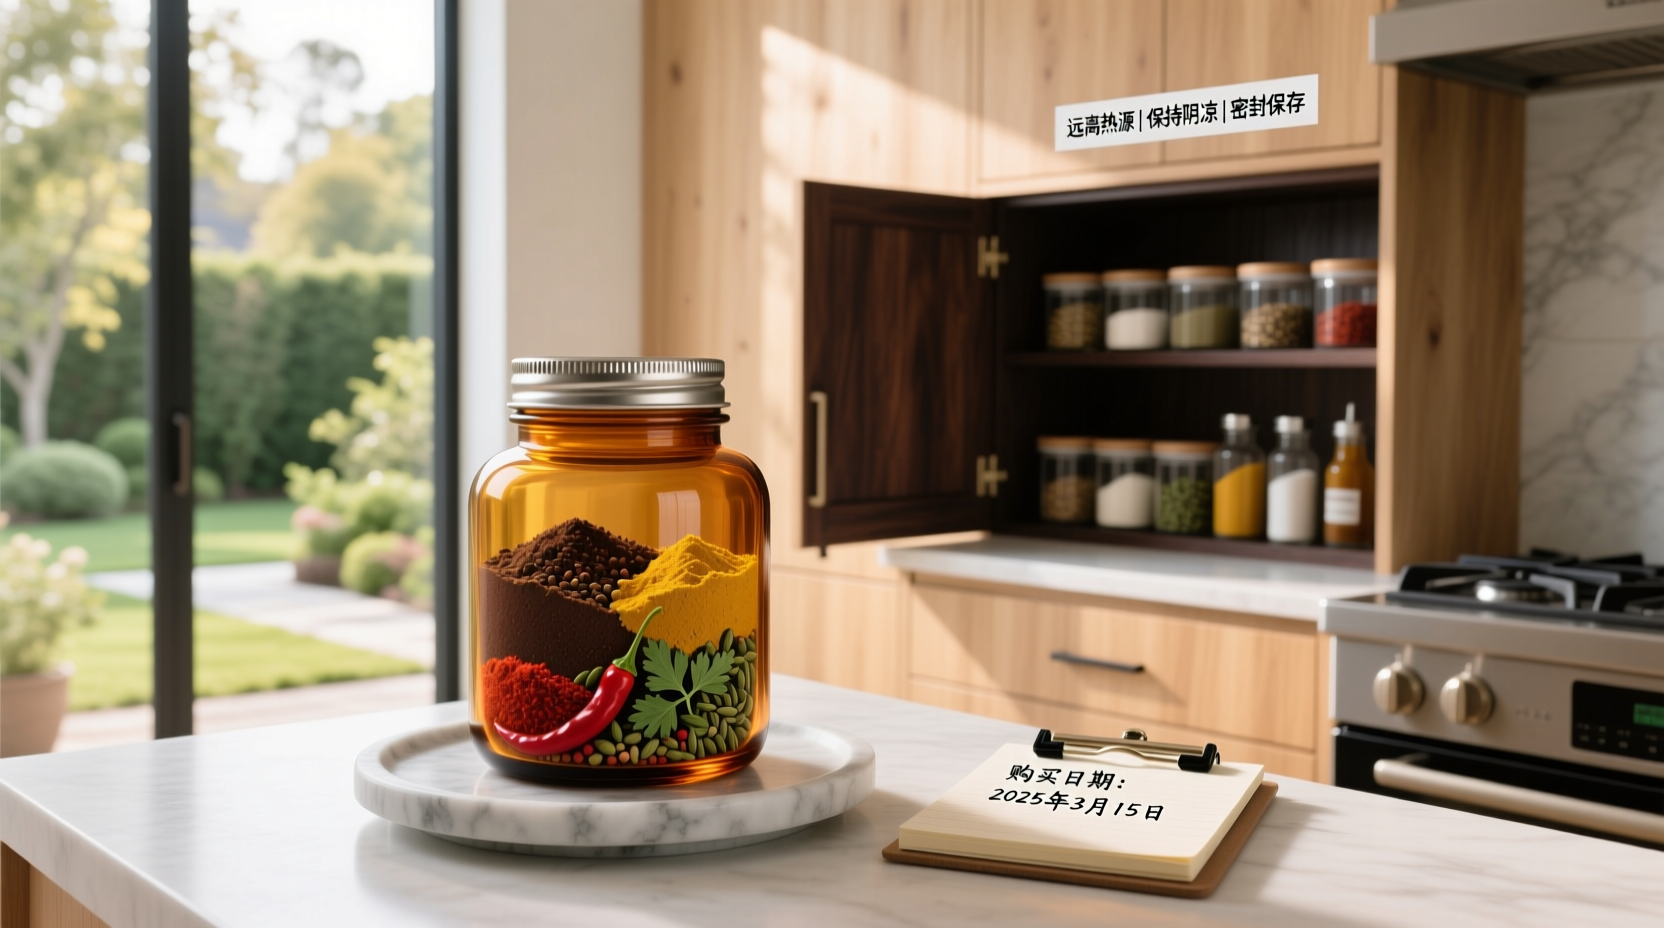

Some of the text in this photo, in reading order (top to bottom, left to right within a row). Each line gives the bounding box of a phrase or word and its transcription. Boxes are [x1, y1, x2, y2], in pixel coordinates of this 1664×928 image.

[1230, 91, 1305, 120] 密封保存
[1005, 764, 1126, 791] 购买日期：
[988, 788, 1164, 821] 2025年3月15日
